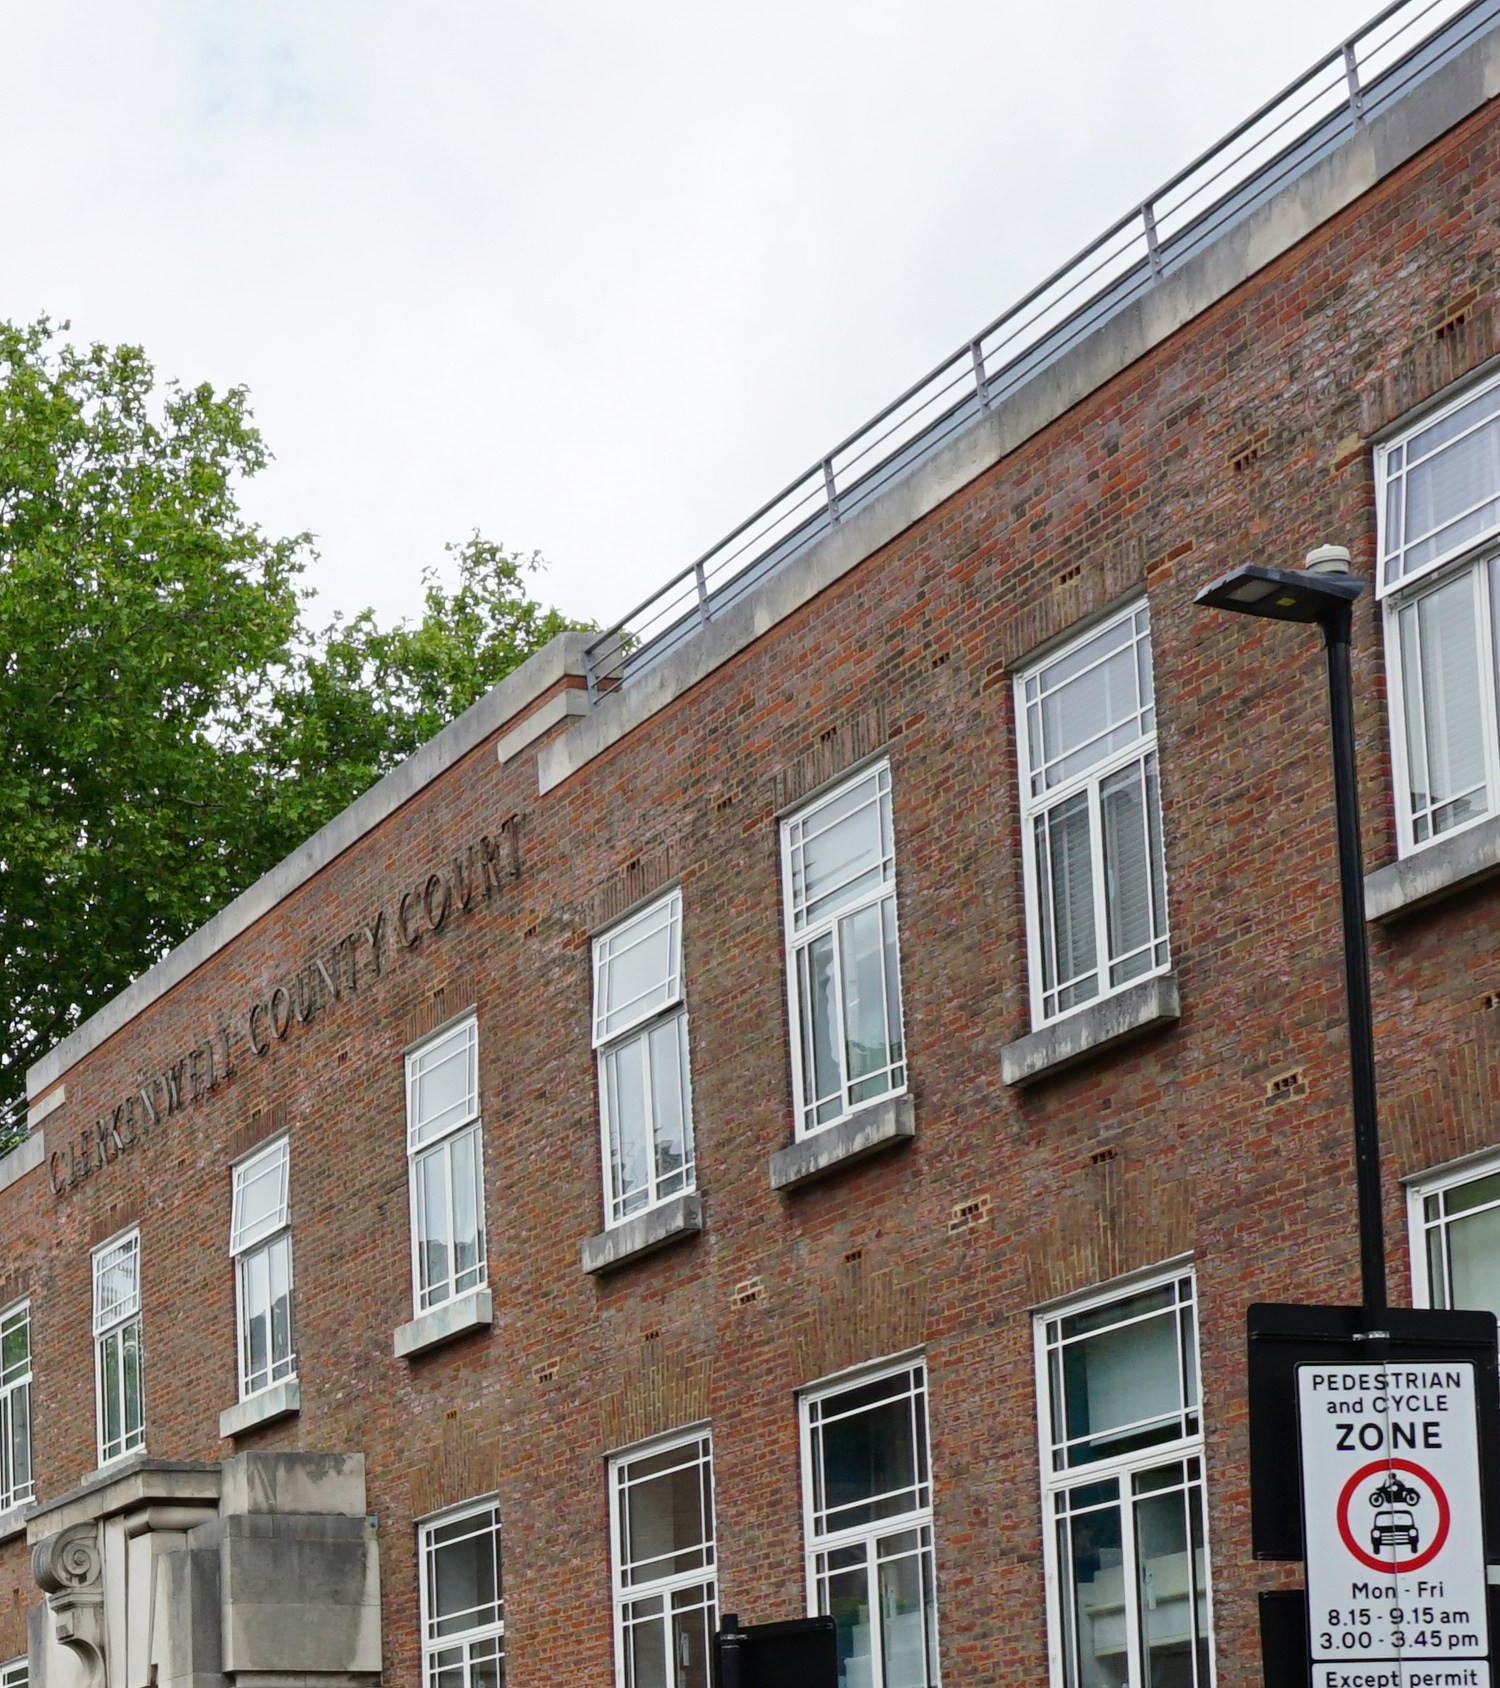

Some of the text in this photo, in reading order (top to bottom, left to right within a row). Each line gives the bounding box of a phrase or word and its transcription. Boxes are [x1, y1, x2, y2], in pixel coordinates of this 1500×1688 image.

[250, 911, 383, 1055] COUNTY
[399, 813, 520, 947] COURT
[1313, 1372, 1461, 1391] PEDESTRIAN
[1327, 1395, 1449, 1414] and CYCLE
[1335, 1421, 1443, 1451] ZONE
[1352, 1582, 1396, 1600] Mon
[1417, 1581, 1444, 1598] Fri
[1328, 1609, 1371, 1626] 8.15
[1389, 1607, 1434, 1625] 9.15
[1440, 1610, 1470, 1624] am
[1320, 1631, 1372, 1649] 3.00
[1391, 1630, 1442, 1648] 3.45
[1448, 1633, 1479, 1650] pm
